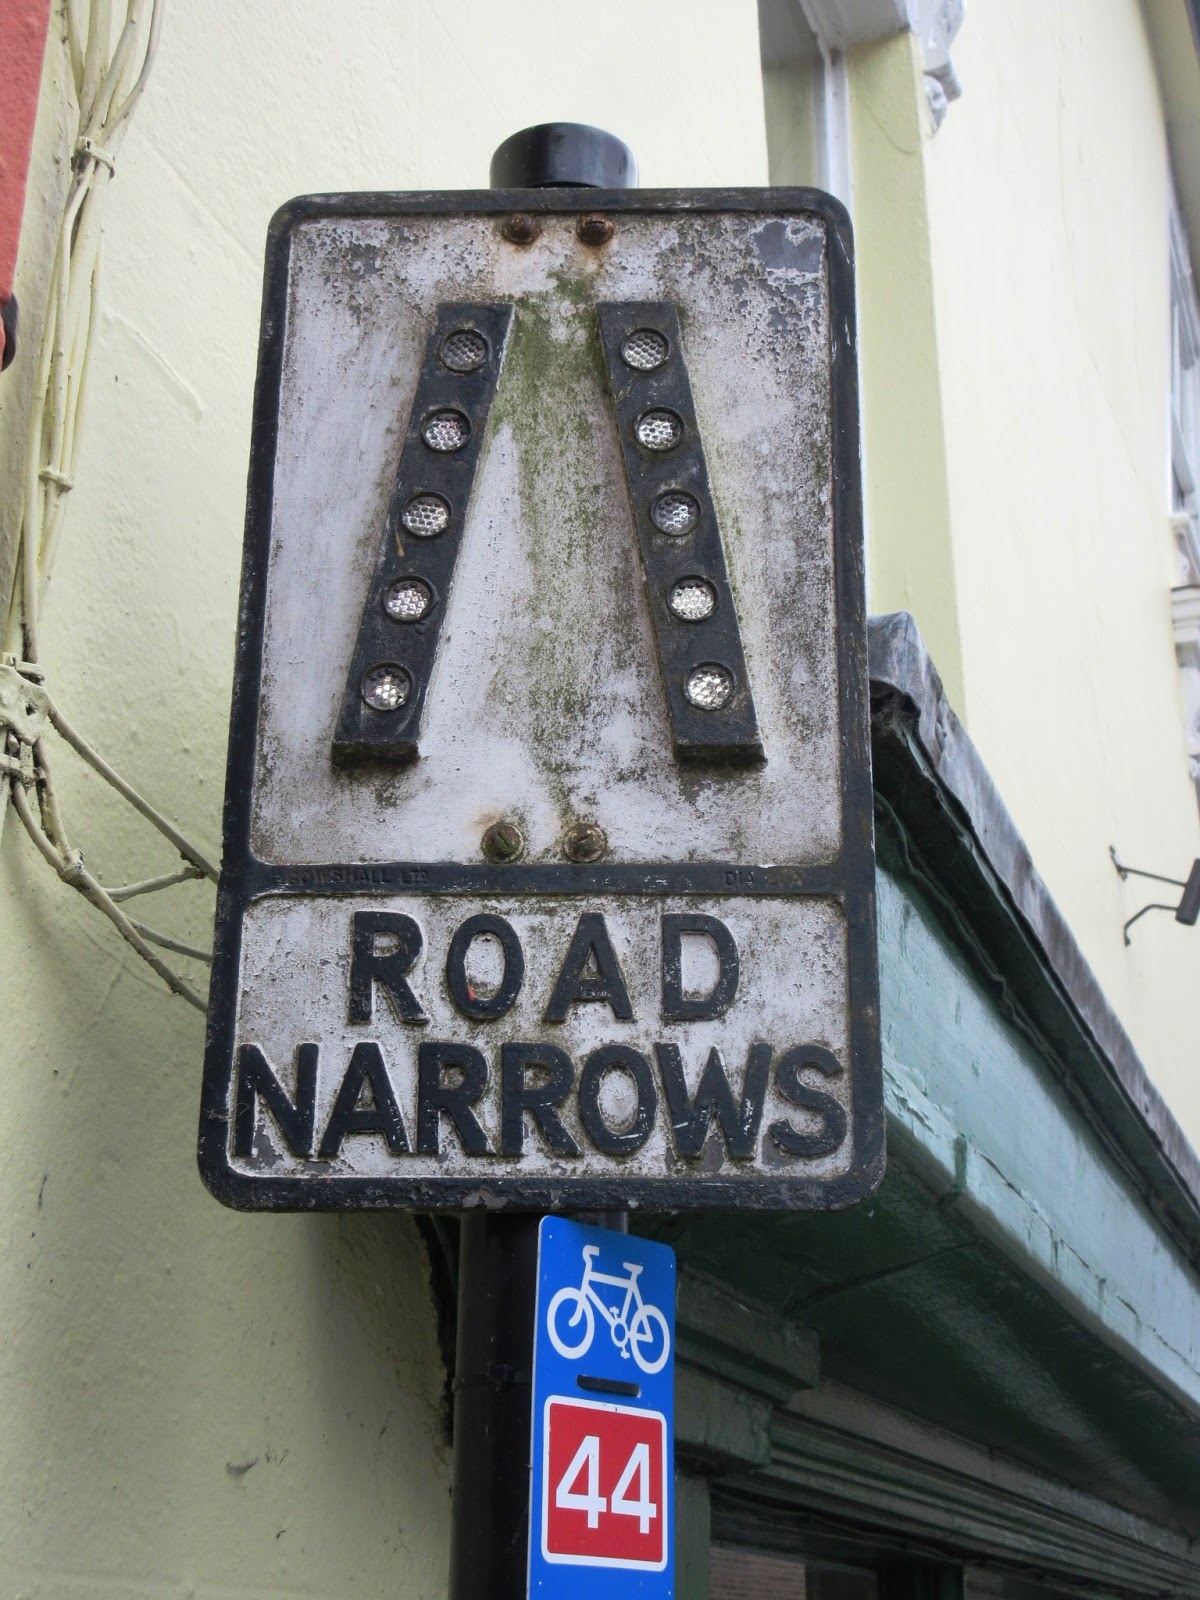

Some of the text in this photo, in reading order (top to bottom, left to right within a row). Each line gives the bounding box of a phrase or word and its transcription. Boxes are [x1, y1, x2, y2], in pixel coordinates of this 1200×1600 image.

[346, 910, 740, 1024] ROAD
[230, 1041, 848, 1161] NARROWS
[555, 1435, 657, 1535] 44
